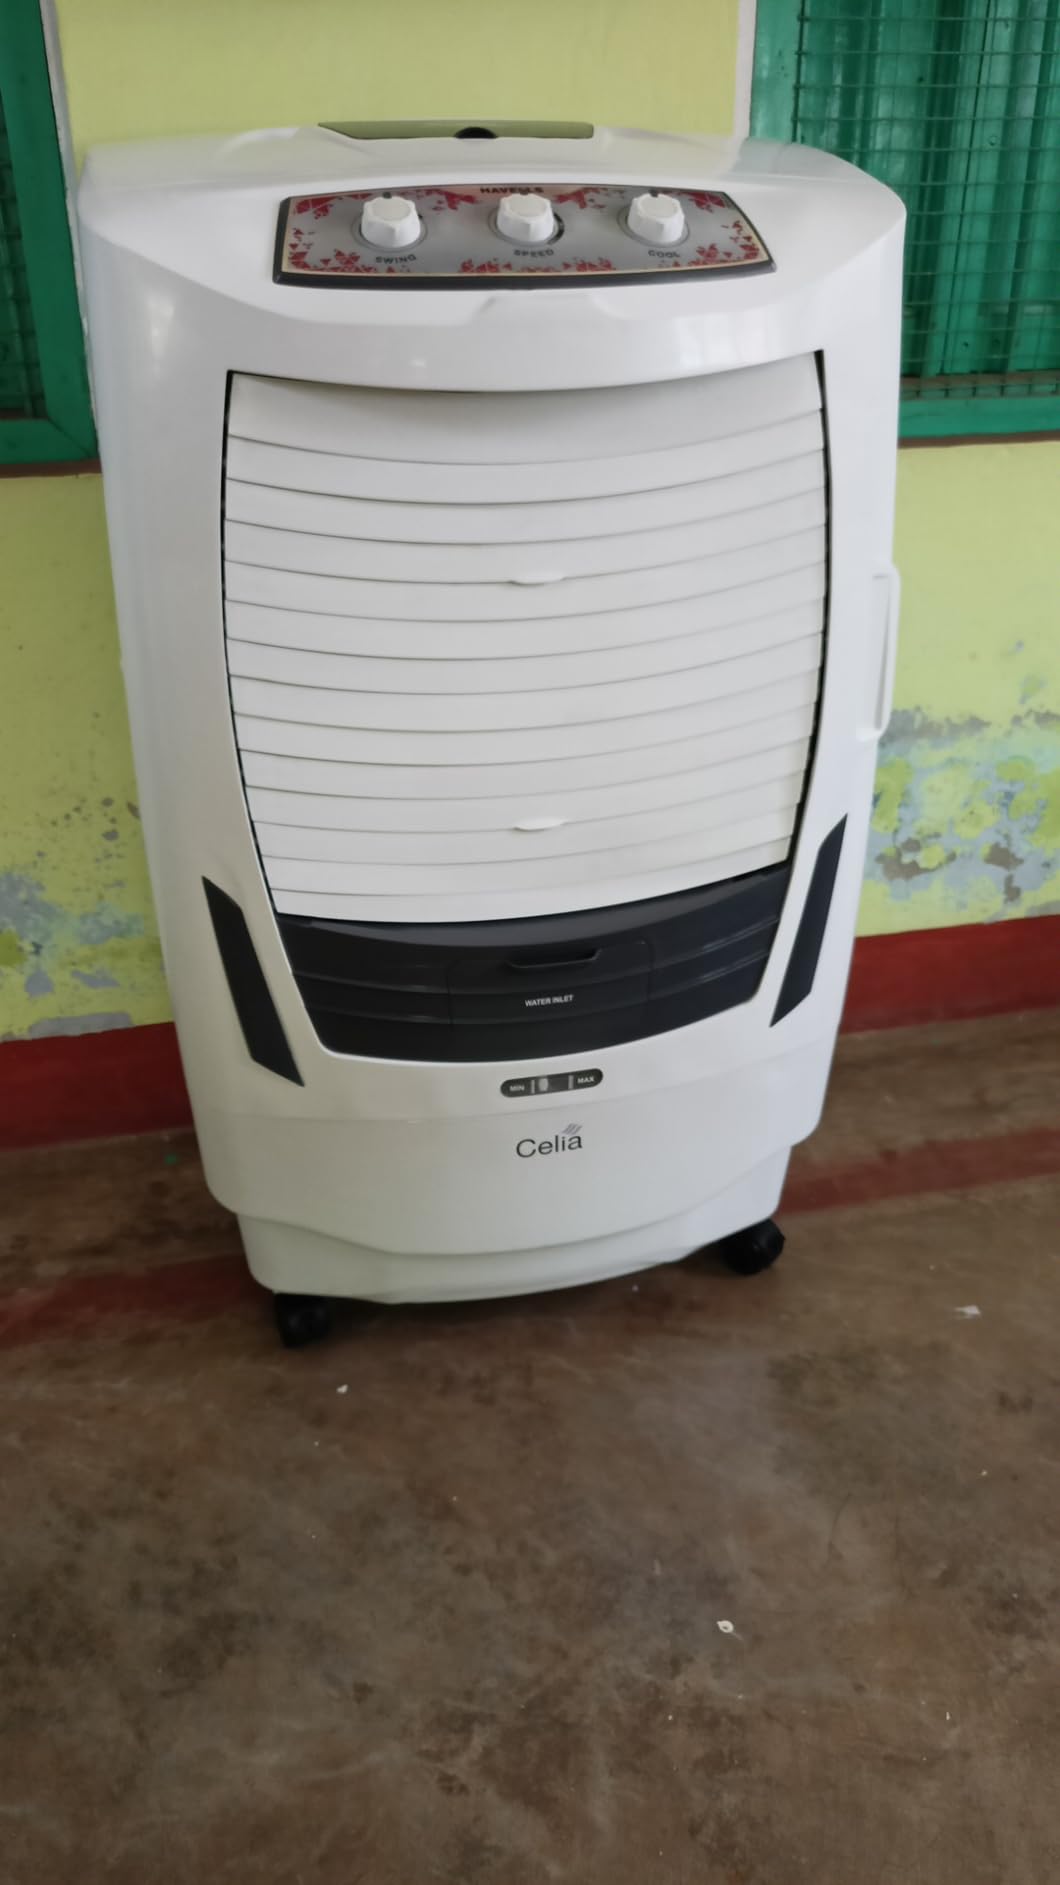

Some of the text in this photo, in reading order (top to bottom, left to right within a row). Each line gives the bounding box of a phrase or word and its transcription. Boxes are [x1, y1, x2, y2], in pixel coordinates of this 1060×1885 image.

[513, 249, 554, 257] SPEED
[647, 249, 681, 258] COOL
[375, 254, 417, 264] SWING
[525, 994, 574, 1006] WATER INLET
[577, 1076, 595, 1084] MAX
[516, 1135, 583, 1159] Celia
